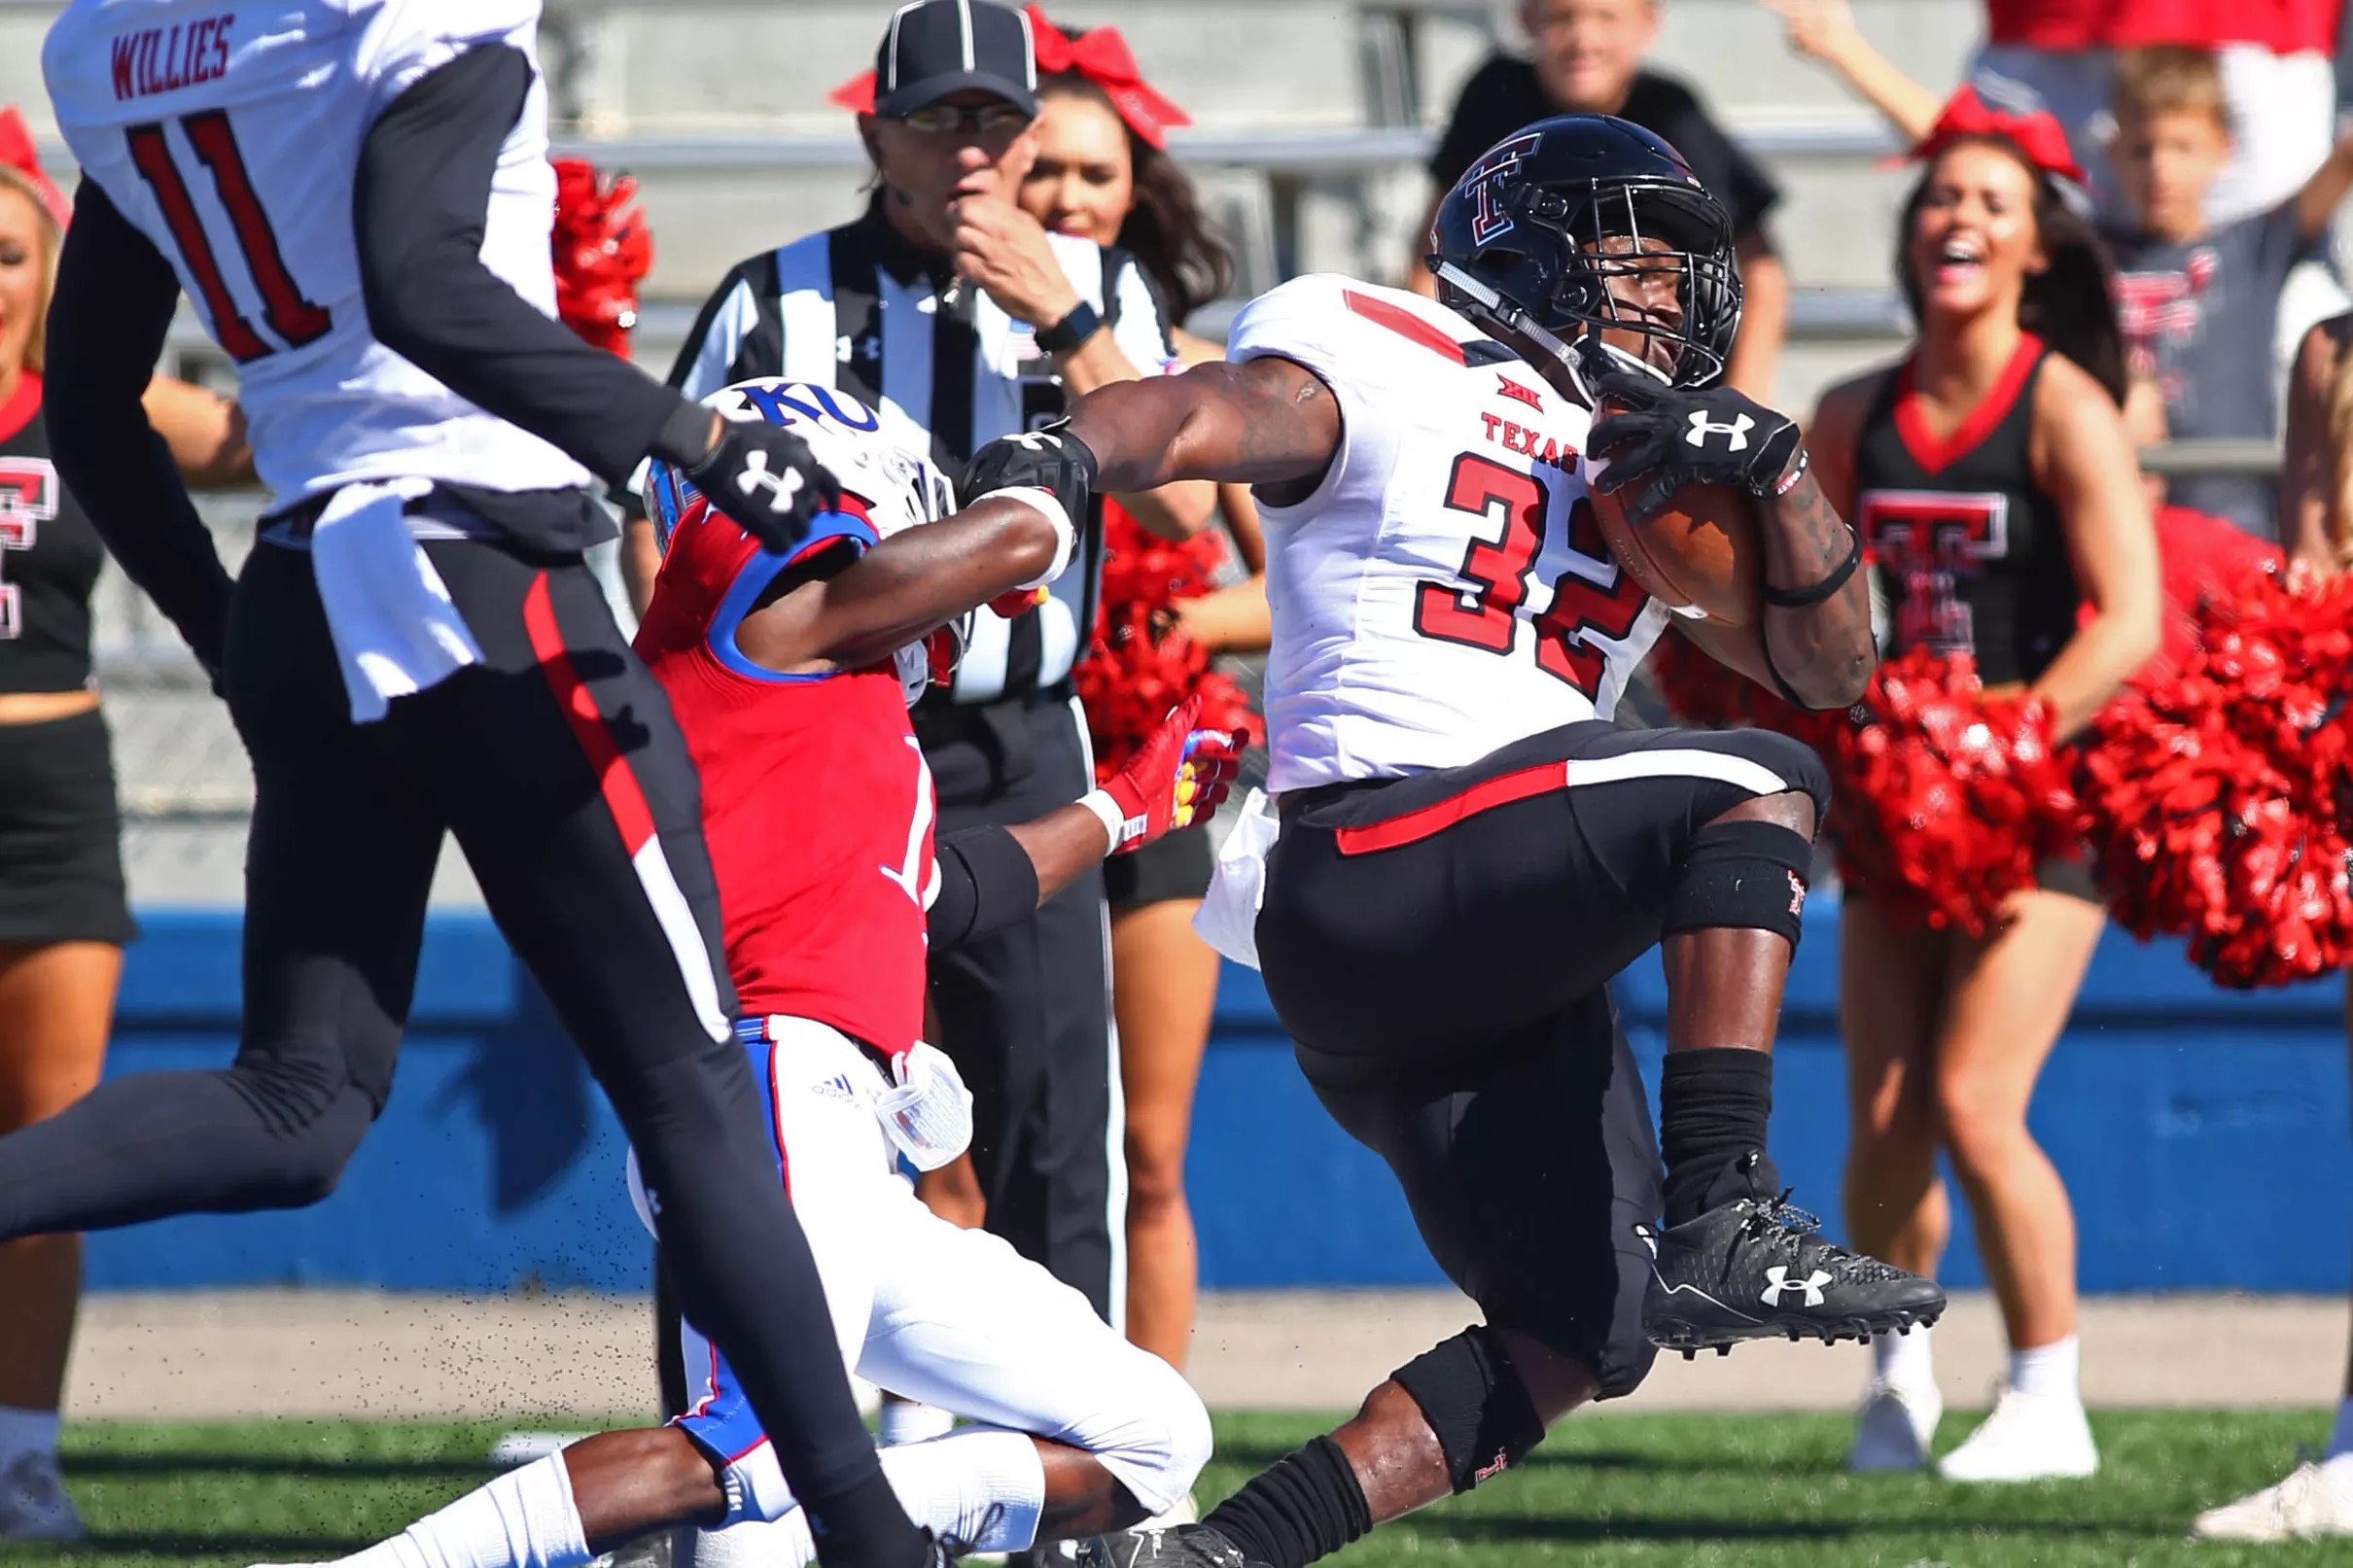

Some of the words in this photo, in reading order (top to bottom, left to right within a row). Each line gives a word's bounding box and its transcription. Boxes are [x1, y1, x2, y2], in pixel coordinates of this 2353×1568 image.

[111, 14, 234, 101] WILLIES
[124, 108, 334, 366] 11
[731, 383, 879, 428] KU
[1481, 411, 1577, 475] TEXAS
[1412, 450, 1652, 706] 32
